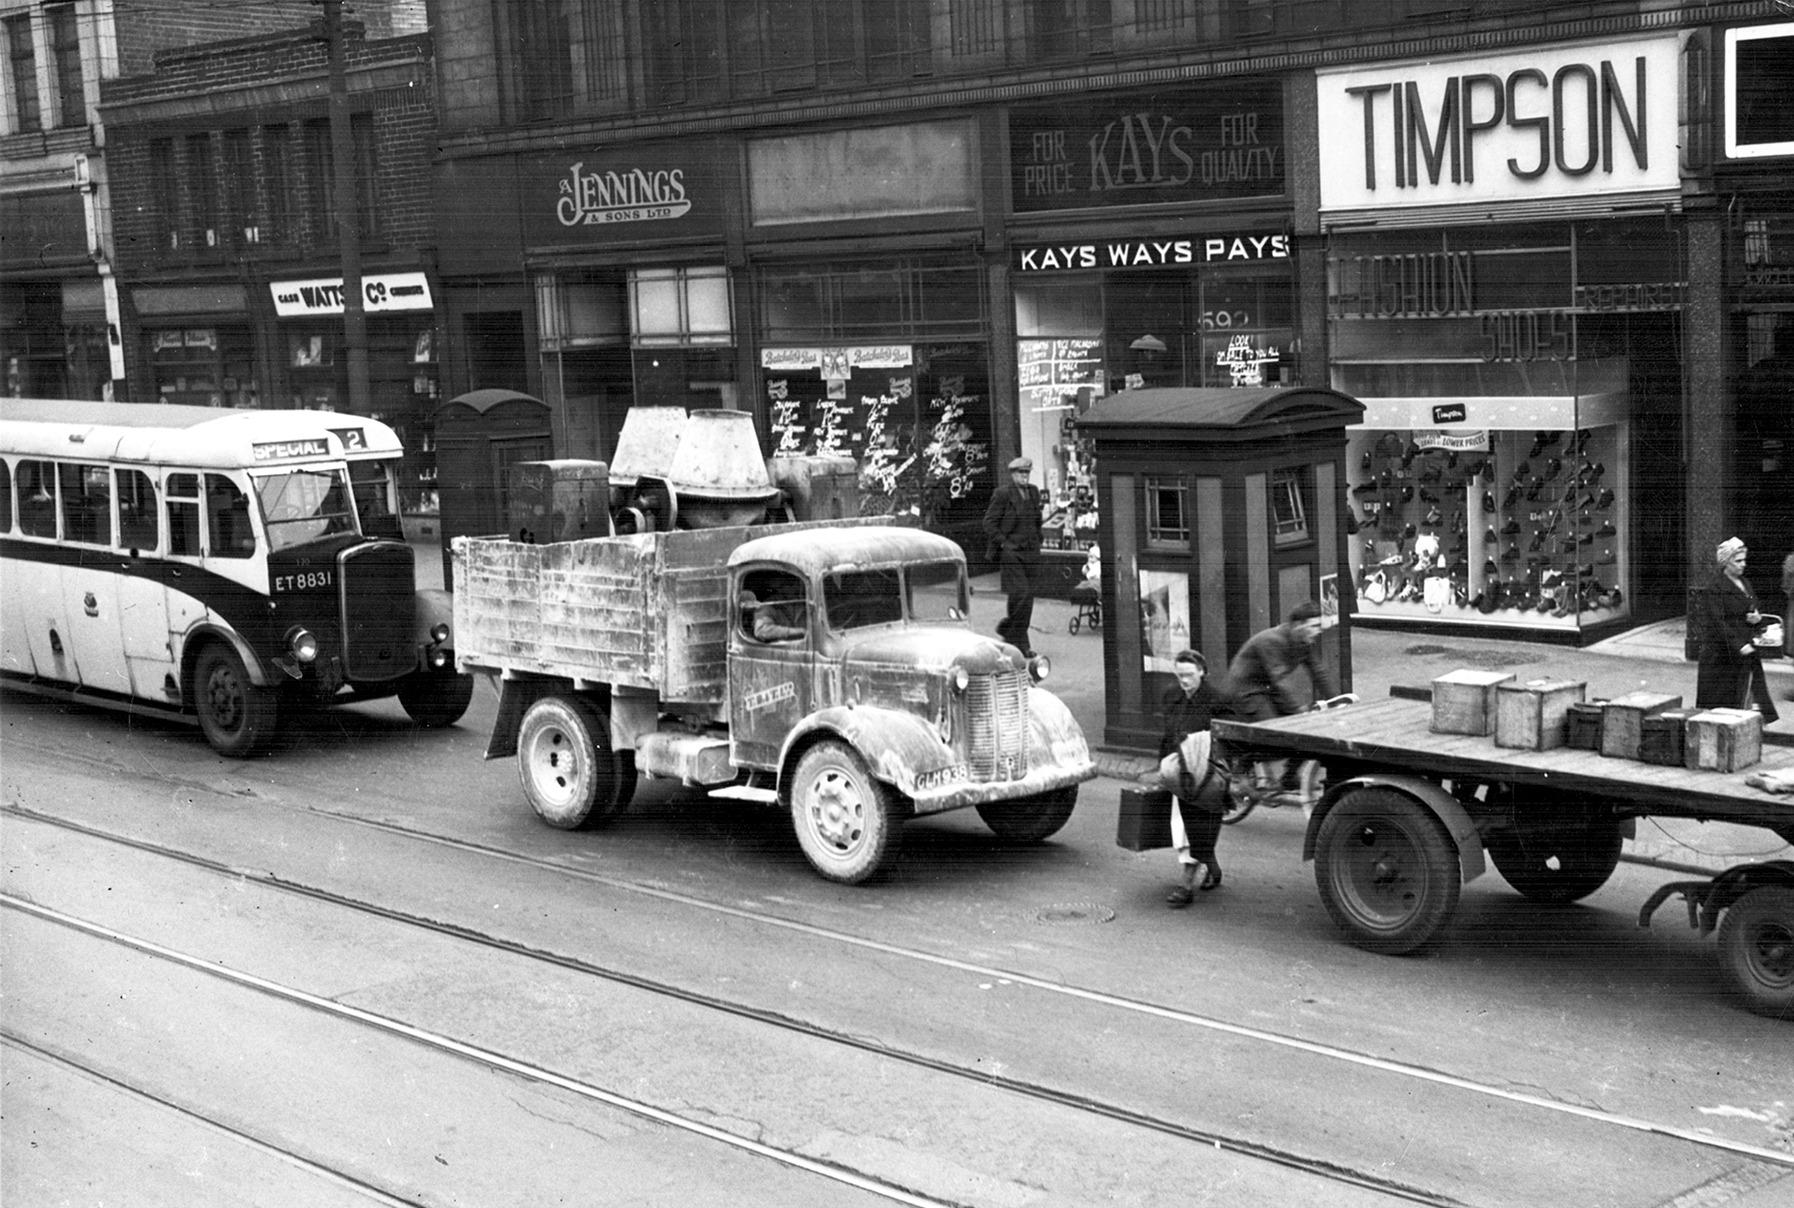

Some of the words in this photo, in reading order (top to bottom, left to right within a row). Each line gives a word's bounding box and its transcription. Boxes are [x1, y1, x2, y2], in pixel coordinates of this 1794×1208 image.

[1221, 112, 1260, 146] FOR
[1345, 56, 1648, 191] TIMPSON
[1033, 130, 1066, 162] FOR
[1088, 112, 1194, 192] KAYS
[1025, 162, 1077, 196] PRICE
[1201, 146, 1279, 185] QUALITY
[557, 162, 686, 226] JENNINGS
[591, 213, 600, 223] &
[605, 210, 640, 221] SONS
[647, 207, 672, 218] LTD
[1021, 245, 1096, 271] KAYS
[1108, 241, 1193, 266] WAYS
[1206, 235, 1290, 261] PAYS
[1481, 312, 1570, 362] SHOES
[255, 442, 326, 459] SPECIAL
[347, 430, 362, 449] 2
